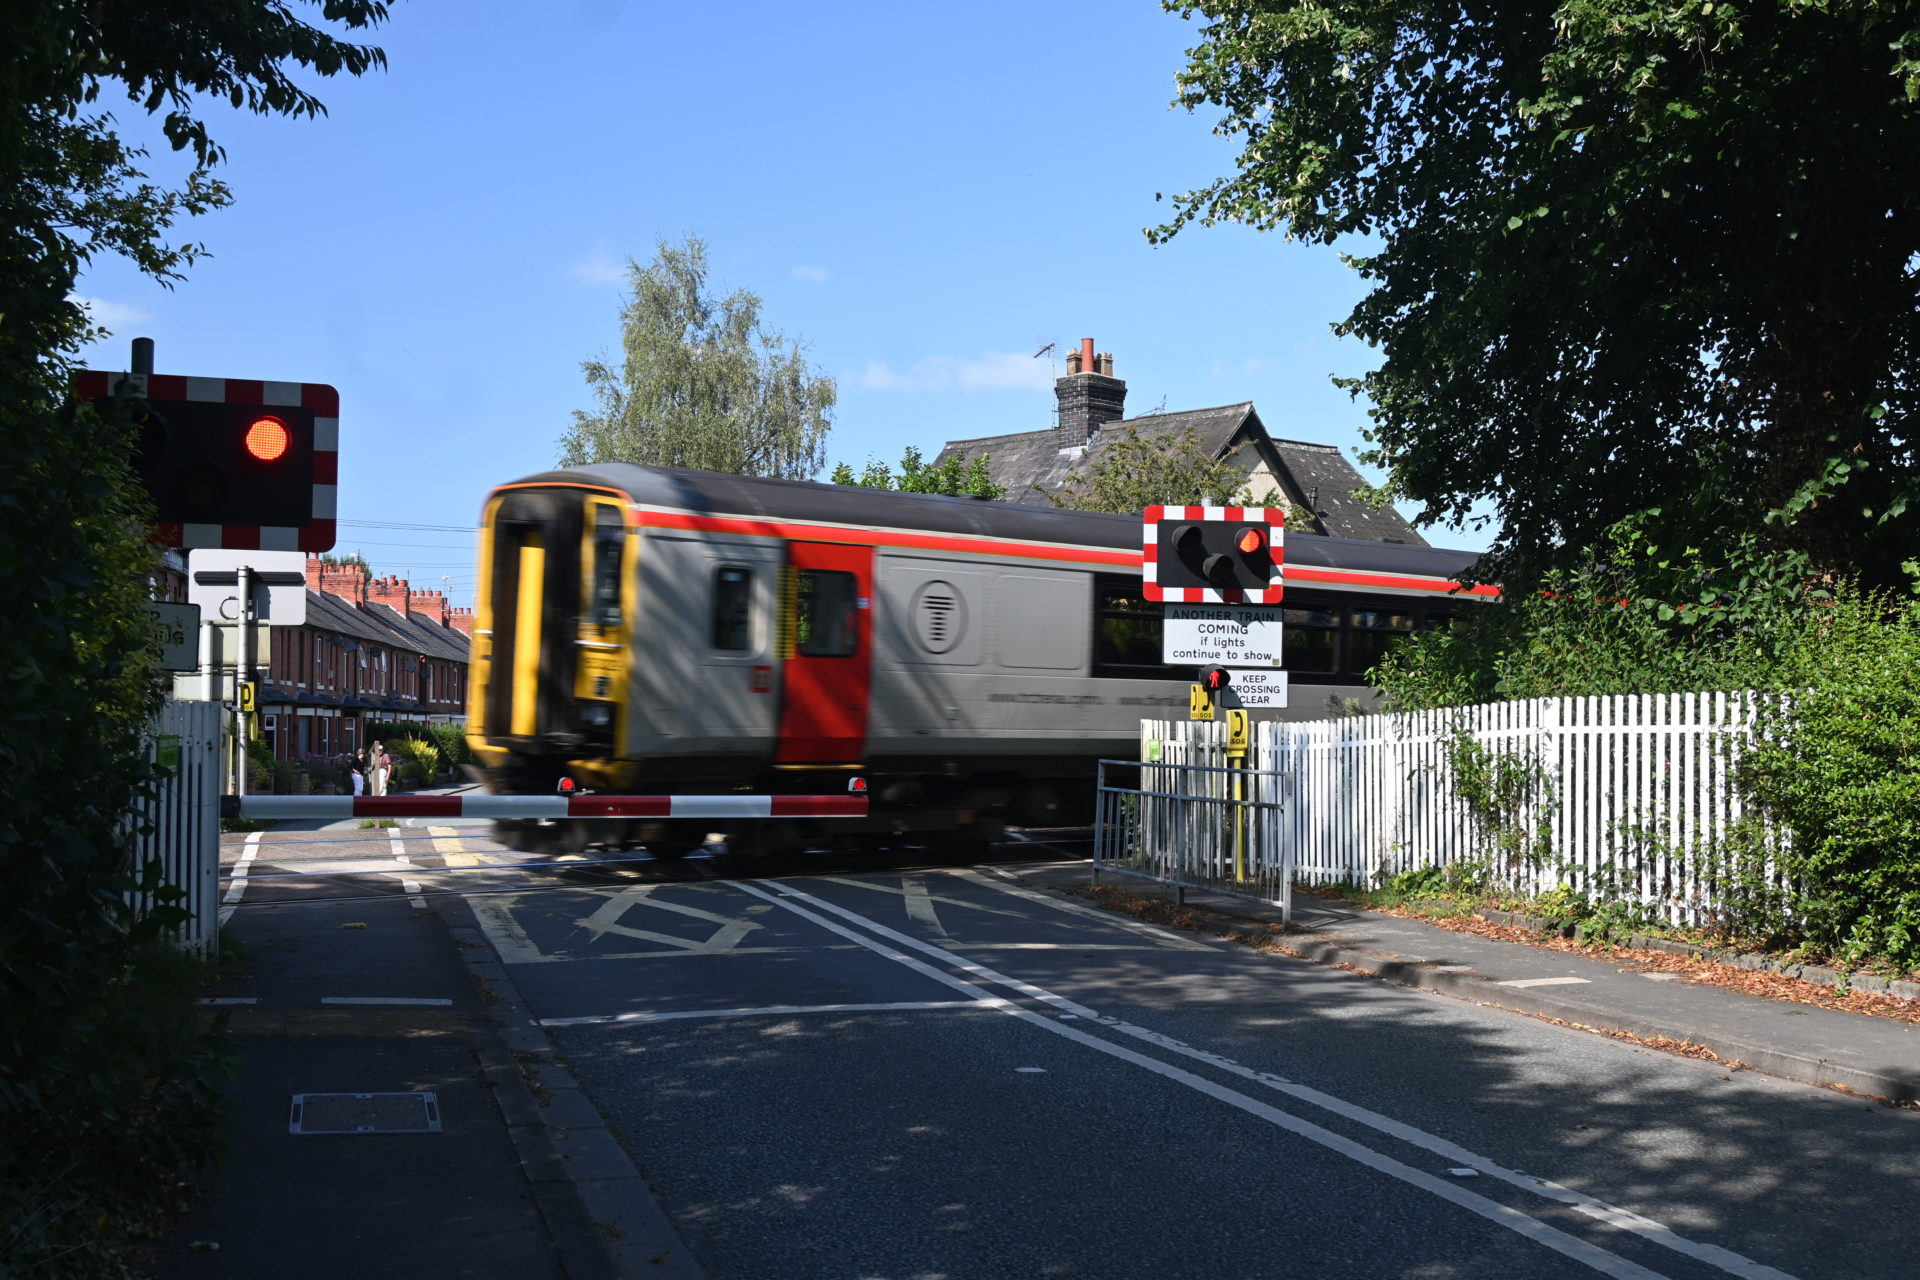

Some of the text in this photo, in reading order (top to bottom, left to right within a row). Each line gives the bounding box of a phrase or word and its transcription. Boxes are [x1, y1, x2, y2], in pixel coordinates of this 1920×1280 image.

[1172, 610, 1275, 622] ANOTHER TRAIN
[1198, 624, 1249, 635] COMING
[1200, 636, 1245, 649] if lights
[1172, 649, 1272, 661] continue to show
[1242, 675, 1267, 683] KEEP
[1229, 685, 1281, 694] CROSSING
[1239, 695, 1270, 704] CLEAR
